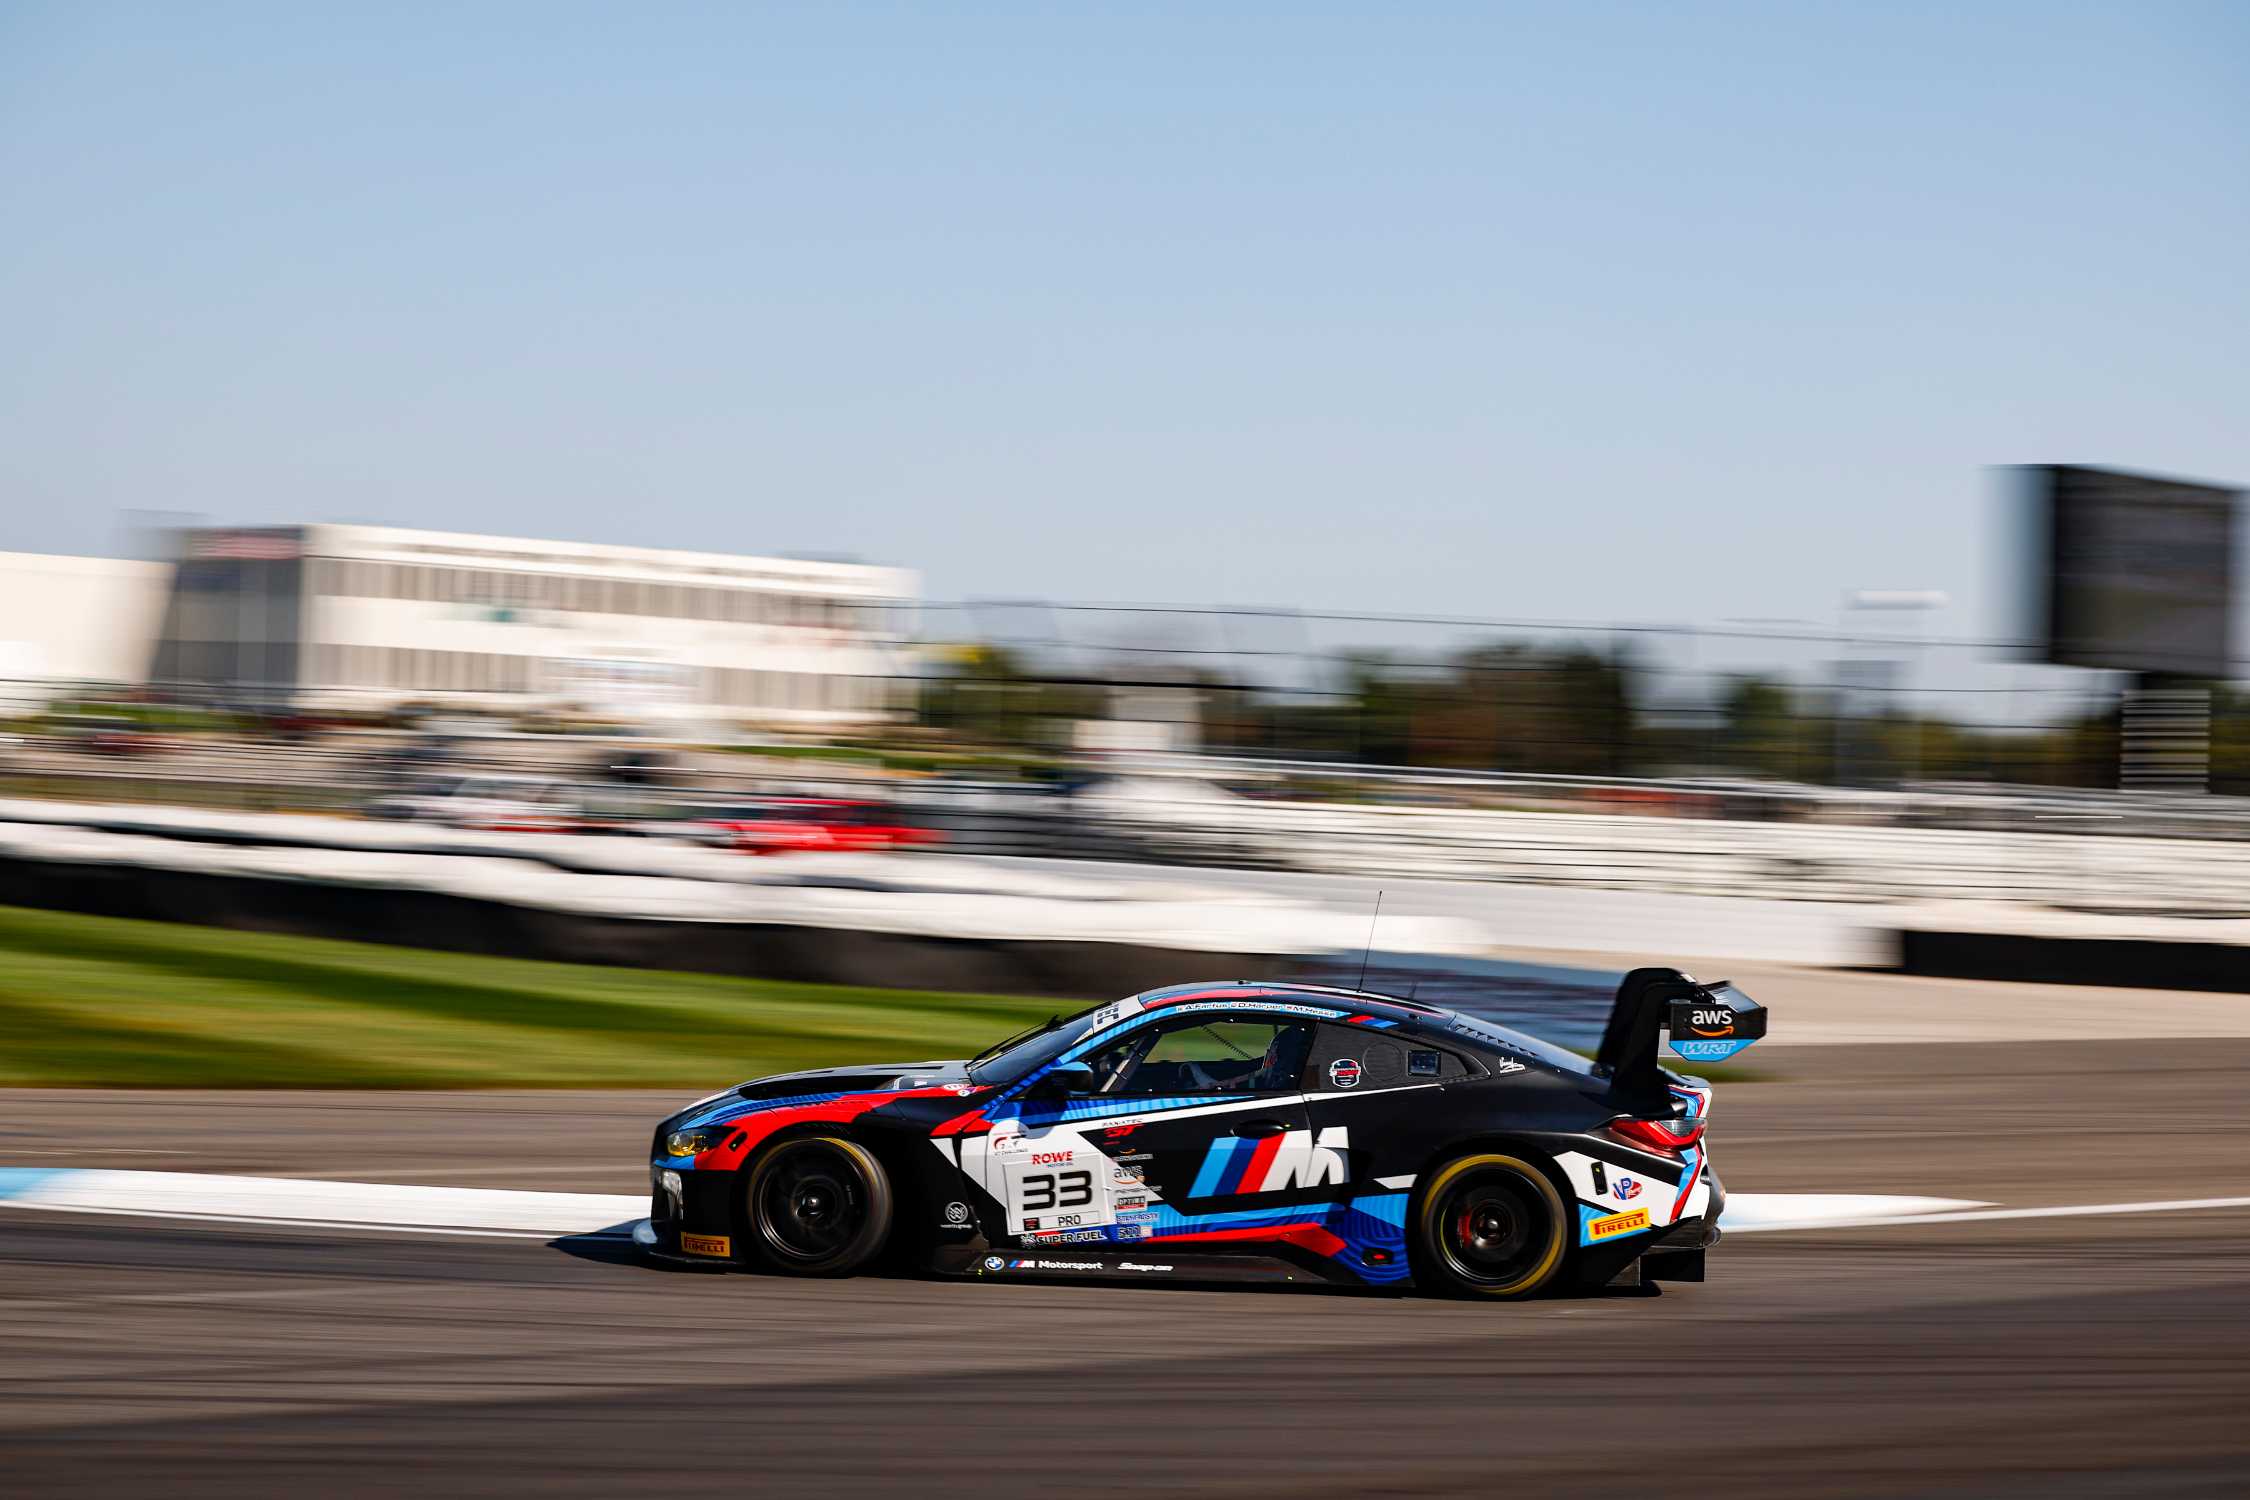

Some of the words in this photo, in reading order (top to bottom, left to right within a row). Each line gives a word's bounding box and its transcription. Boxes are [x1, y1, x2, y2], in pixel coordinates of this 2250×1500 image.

[1691, 1010, 1733, 1025] aws
[1682, 1041, 1736, 1054] WRT
[1031, 1150, 1073, 1165] ROWE
[1113, 1165, 1144, 1178] aws
[1022, 1170, 1093, 1212] 33
[1613, 1178, 1632, 1200] VP
[1057, 1214, 1082, 1227] PRO
[1594, 1212, 1645, 1235] PIRELLI
[1037, 1233, 1075, 1244] SUPER
[1076, 1230, 1104, 1242] FUEL
[684, 1237, 725, 1253] PIRELLI
[1038, 1260, 1104, 1270] Motorsport
[1117, 1262, 1174, 1272] Snap-on
